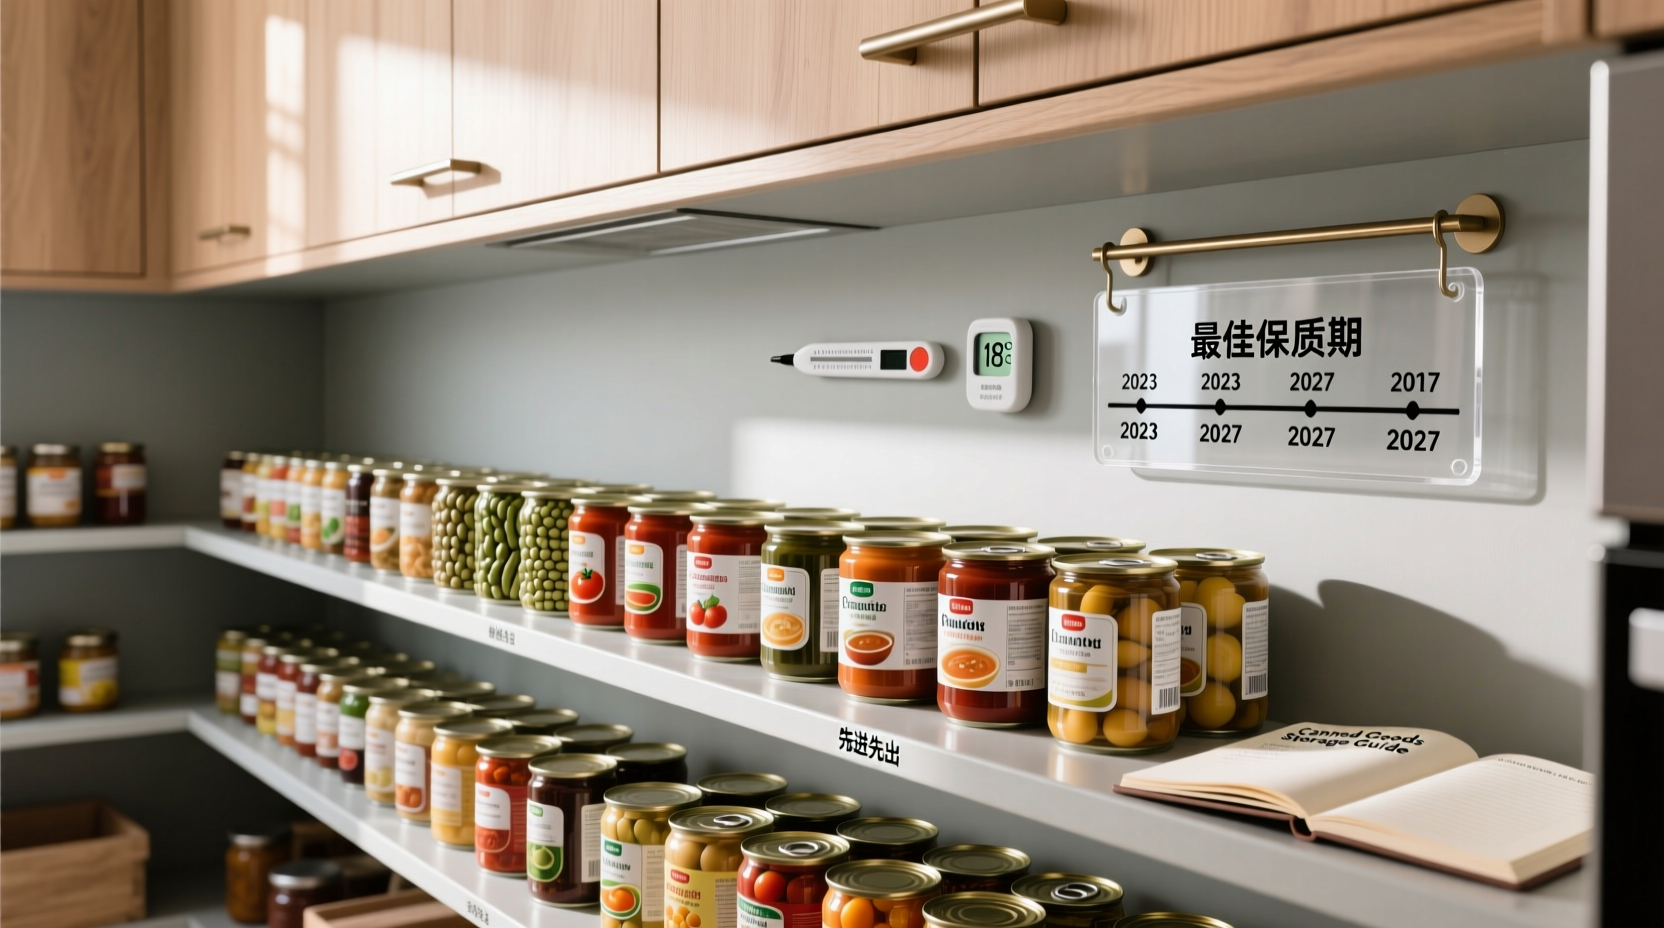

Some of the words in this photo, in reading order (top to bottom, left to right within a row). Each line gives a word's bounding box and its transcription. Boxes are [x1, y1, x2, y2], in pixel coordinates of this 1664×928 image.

[1190, 315, 1363, 360] 最佳保质期
[1121, 372, 1158, 391] 2023
[1201, 372, 1241, 391] 2023
[1289, 372, 1335, 392] 2027
[1390, 372, 1441, 393] 2017
[1120, 421, 1158, 440] 2023
[1199, 423, 1243, 444] 2027
[1287, 426, 1336, 448] 2027
[1386, 429, 1441, 452] 2027
[838, 726, 901, 768] 先进先出
[1281, 732, 1350, 747] Storage
[1353, 739, 1409, 754] Guide
[1298, 727, 1364, 739] Canned
[1365, 730, 1425, 746] Goods
